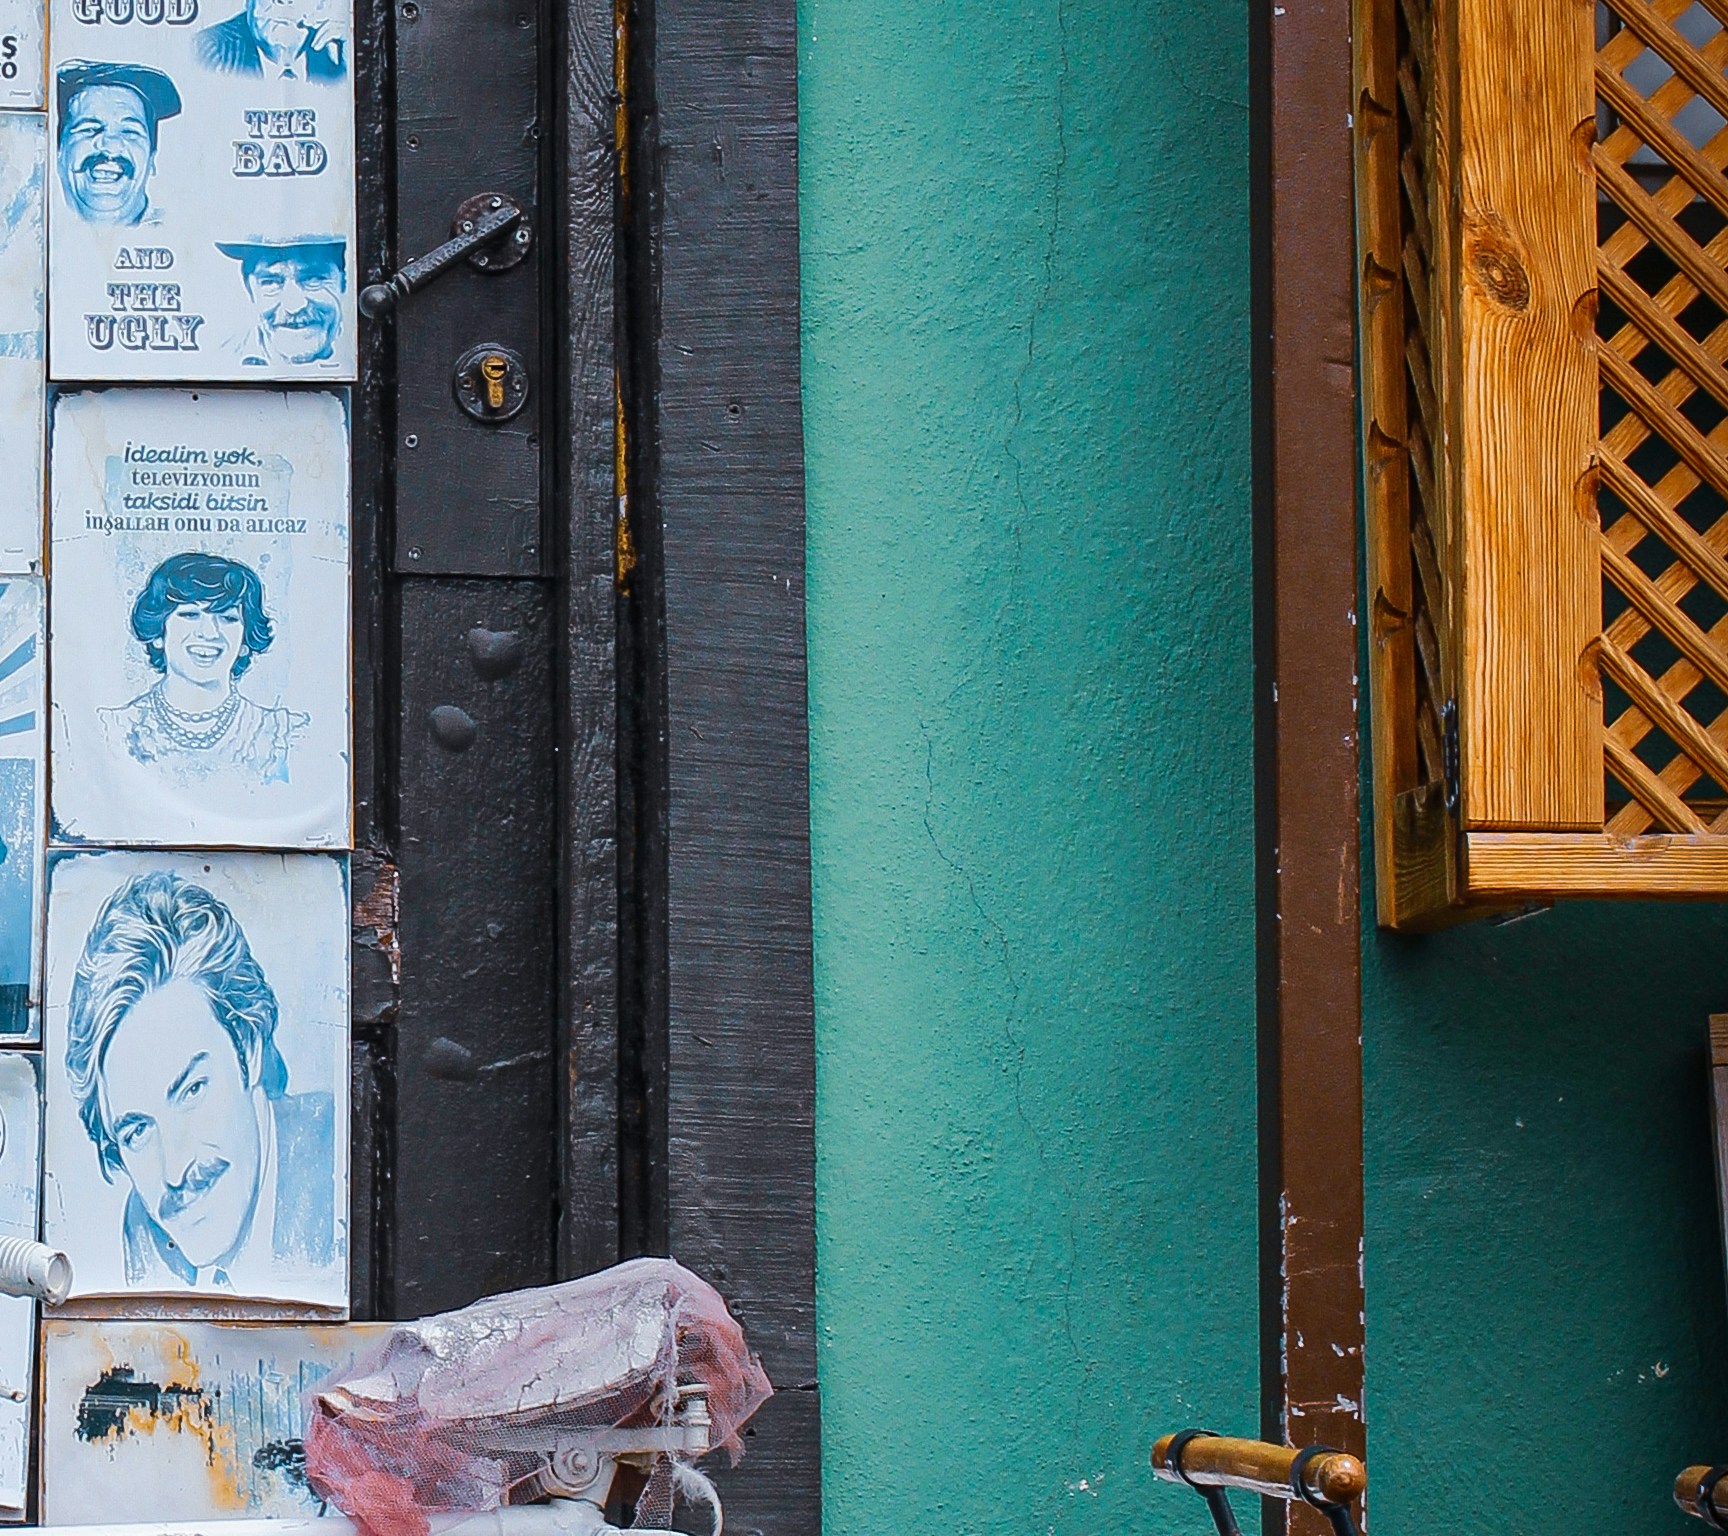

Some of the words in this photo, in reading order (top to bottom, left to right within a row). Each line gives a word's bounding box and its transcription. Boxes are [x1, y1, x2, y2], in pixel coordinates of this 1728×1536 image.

[243, 108, 316, 139] THE
[232, 140, 328, 177] BAD
[114, 247, 175, 269] AND
[106, 283, 181, 312] THE
[84, 314, 206, 351] UGLY
[124, 441, 209, 465] İdealim
[213, 447, 264, 468] yok,
[123, 492, 201, 511] taksidi
[206, 493, 269, 512] bitsin
[174, 516, 212, 532] onu
